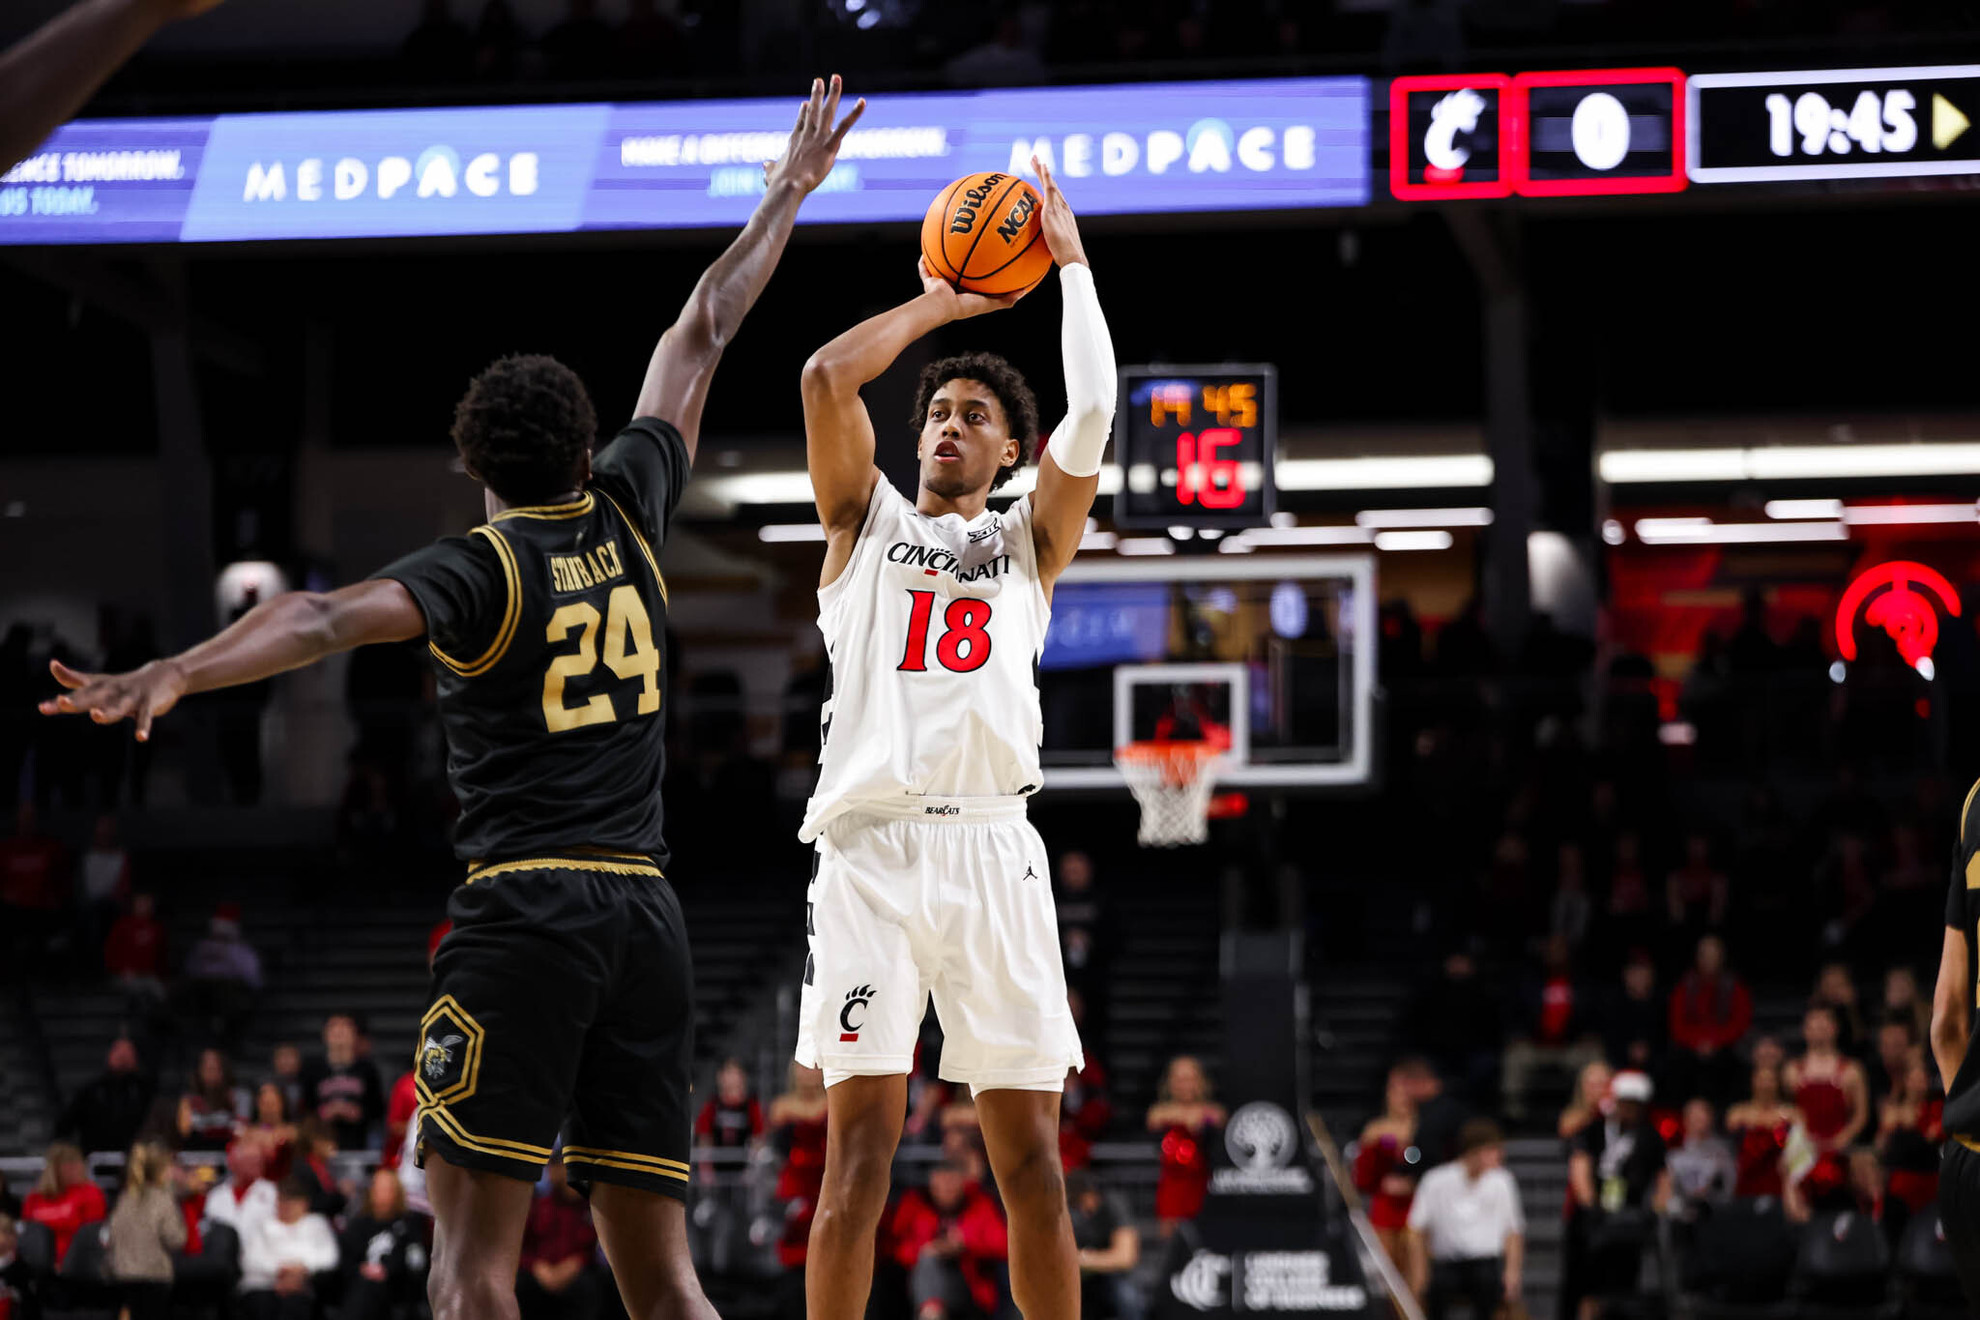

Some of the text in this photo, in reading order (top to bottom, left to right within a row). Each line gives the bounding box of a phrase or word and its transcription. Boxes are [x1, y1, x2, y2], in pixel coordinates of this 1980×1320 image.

[1008, 125, 1316, 178] MEDPACE
[1572, 92, 1630, 170] 0
[1765, 89, 1916, 156] 19:45
[62, 149, 185, 182] TOMORROW.
[243, 153, 539, 202] MEDPACE
[950, 172, 1008, 235] Wilson
[996, 190, 1038, 245] NCAA
[1176, 427, 1246, 509] 16
[887, 541, 1010, 583] CINCINNATI
[542, 584, 660, 733] 24
[896, 588, 993, 673] 18
[924, 804, 960, 816] BEARCATS
